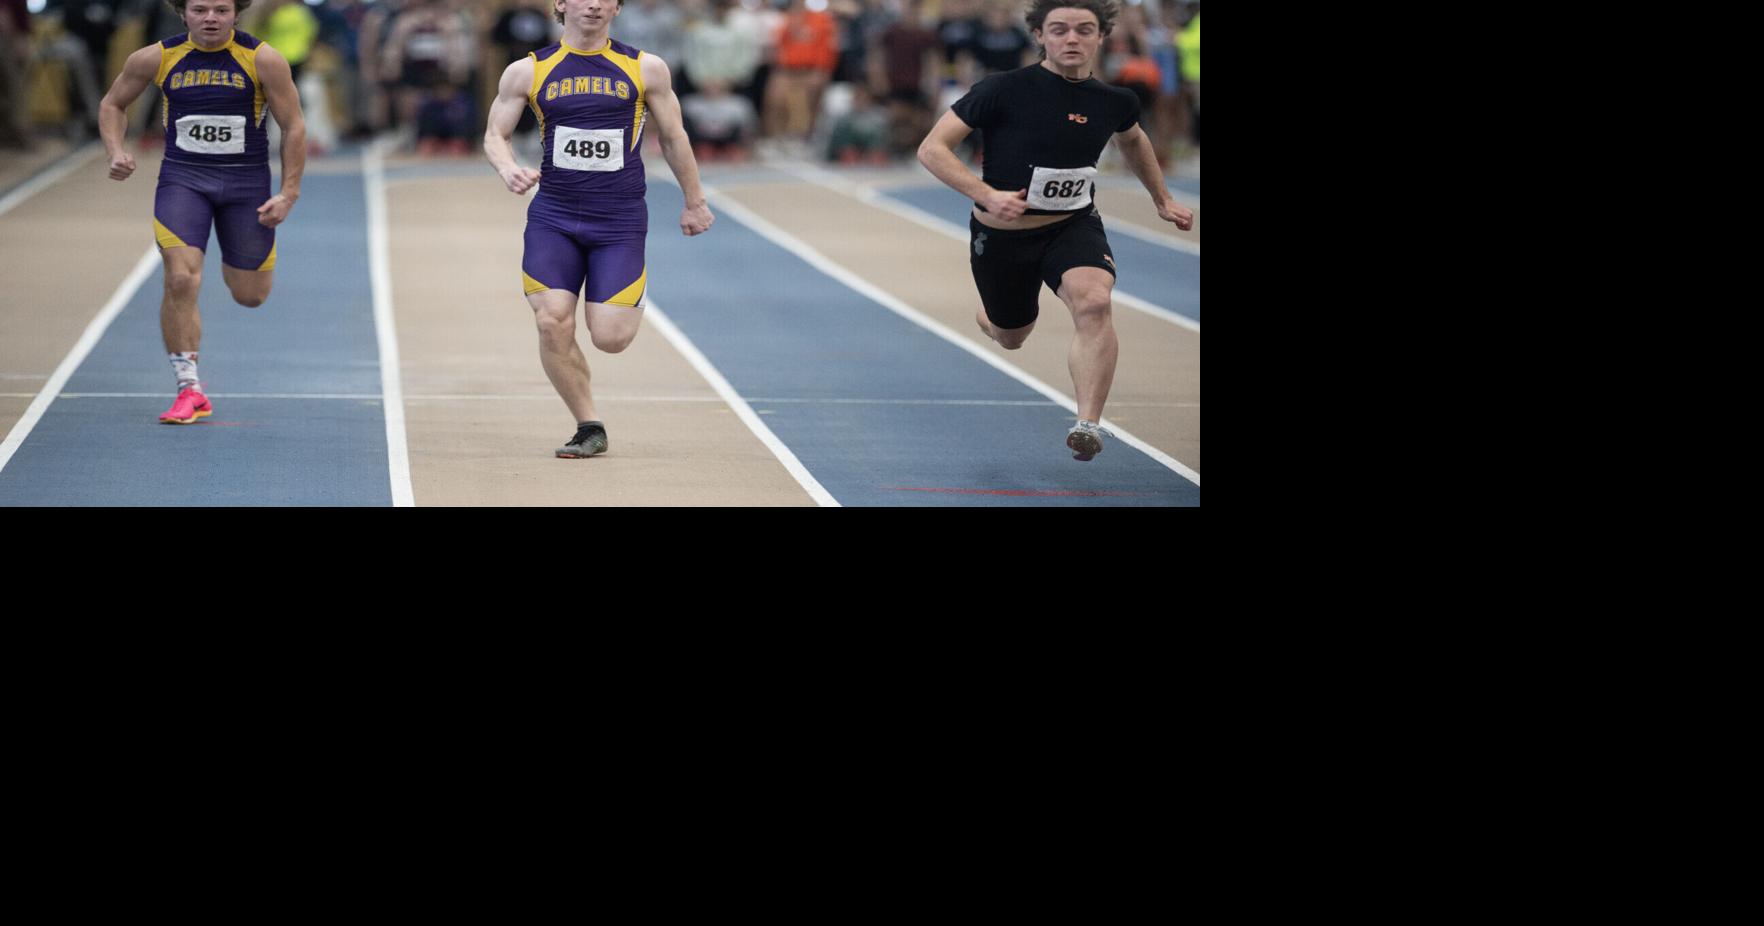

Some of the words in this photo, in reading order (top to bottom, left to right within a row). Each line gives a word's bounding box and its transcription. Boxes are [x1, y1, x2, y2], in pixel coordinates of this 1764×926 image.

[170, 69, 246, 90] CAMELS
[545, 76, 630, 101] CAMELS
[188, 124, 232, 142] 485
[564, 139, 611, 159] 489
[1043, 179, 1086, 198] 682
